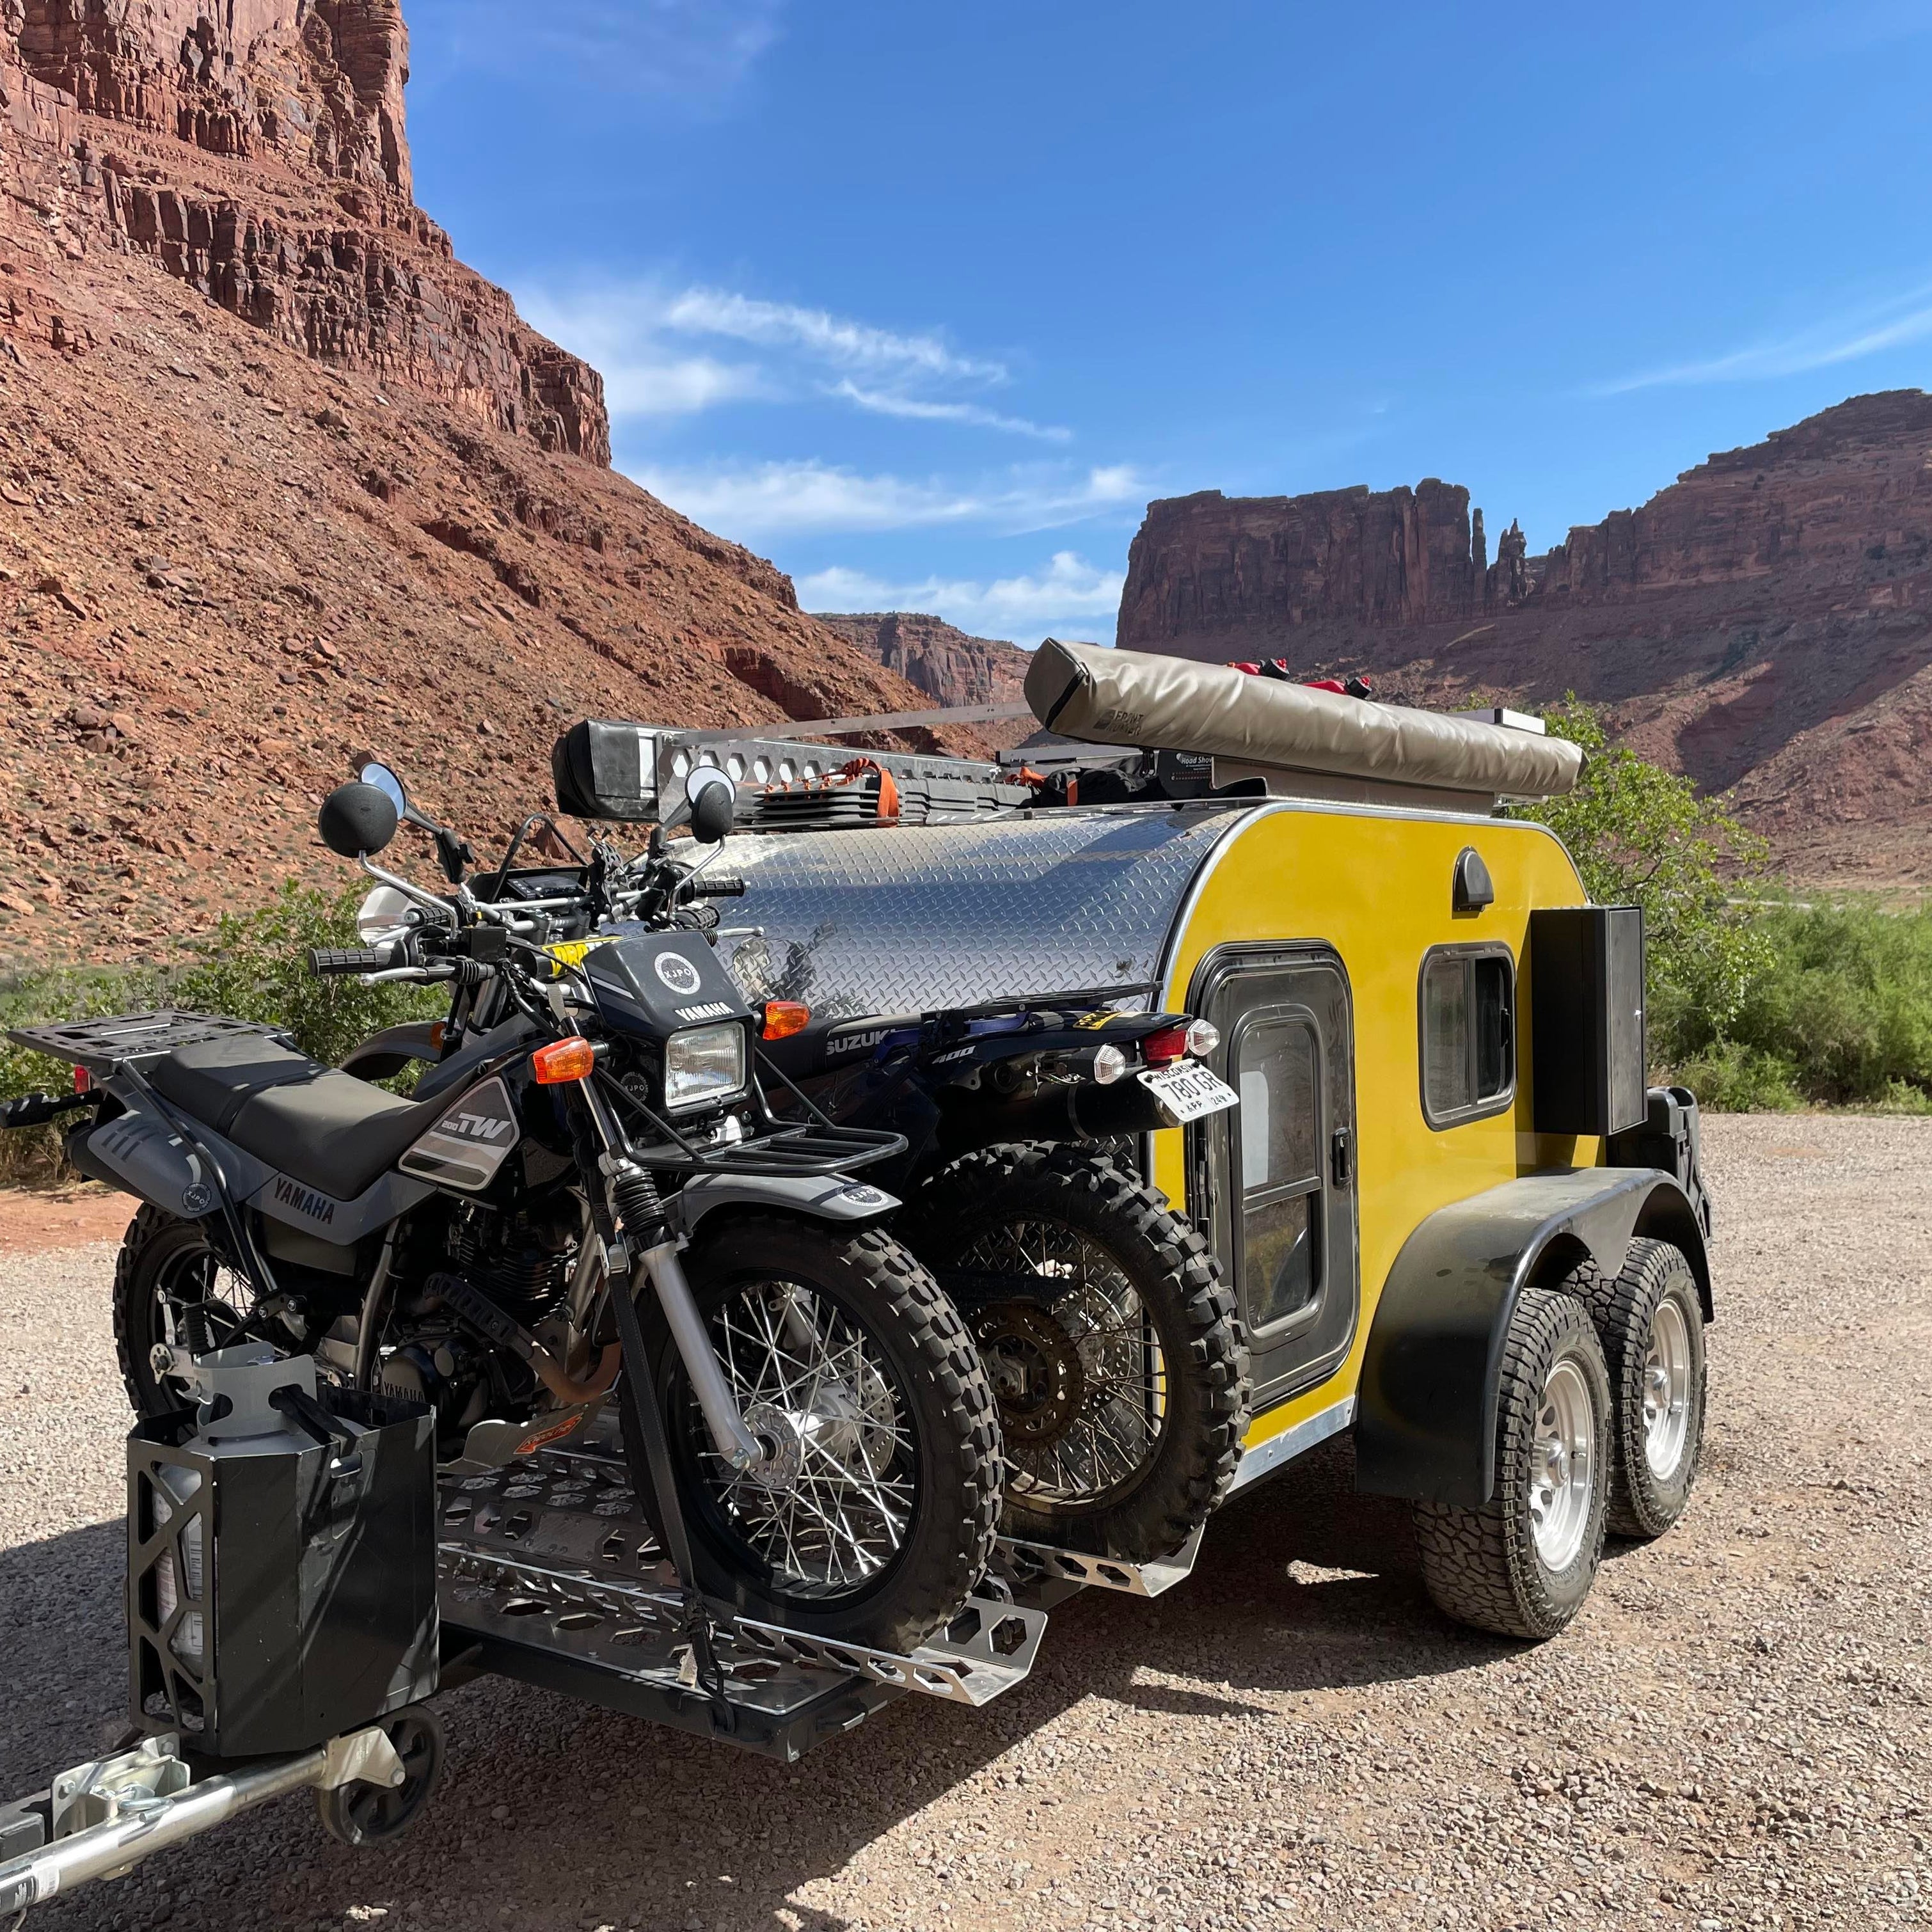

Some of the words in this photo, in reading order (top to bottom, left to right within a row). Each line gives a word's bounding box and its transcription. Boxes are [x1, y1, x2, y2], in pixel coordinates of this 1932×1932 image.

[1115, 710, 1144, 724] FRONT
[1181, 756, 1198, 764] Road
[663, 967, 692, 979] XJPO
[674, 1002, 735, 1022] YAMAHA
[827, 1028, 896, 1056] SUZUK
[932, 1045, 976, 1065] 400
[1154, 1064, 1195, 1081] WISCONSIN
[1160, 1077, 1201, 1102] 780
[1192, 1071, 1223, 1091] GR
[441, 1120, 459, 1131] 200
[458, 1112, 512, 1139] TW
[186, 1191, 206, 1205] XJPO
[274, 1176, 335, 1224] YAMAHA
[384, 1381, 425, 1403] YAMAHA
